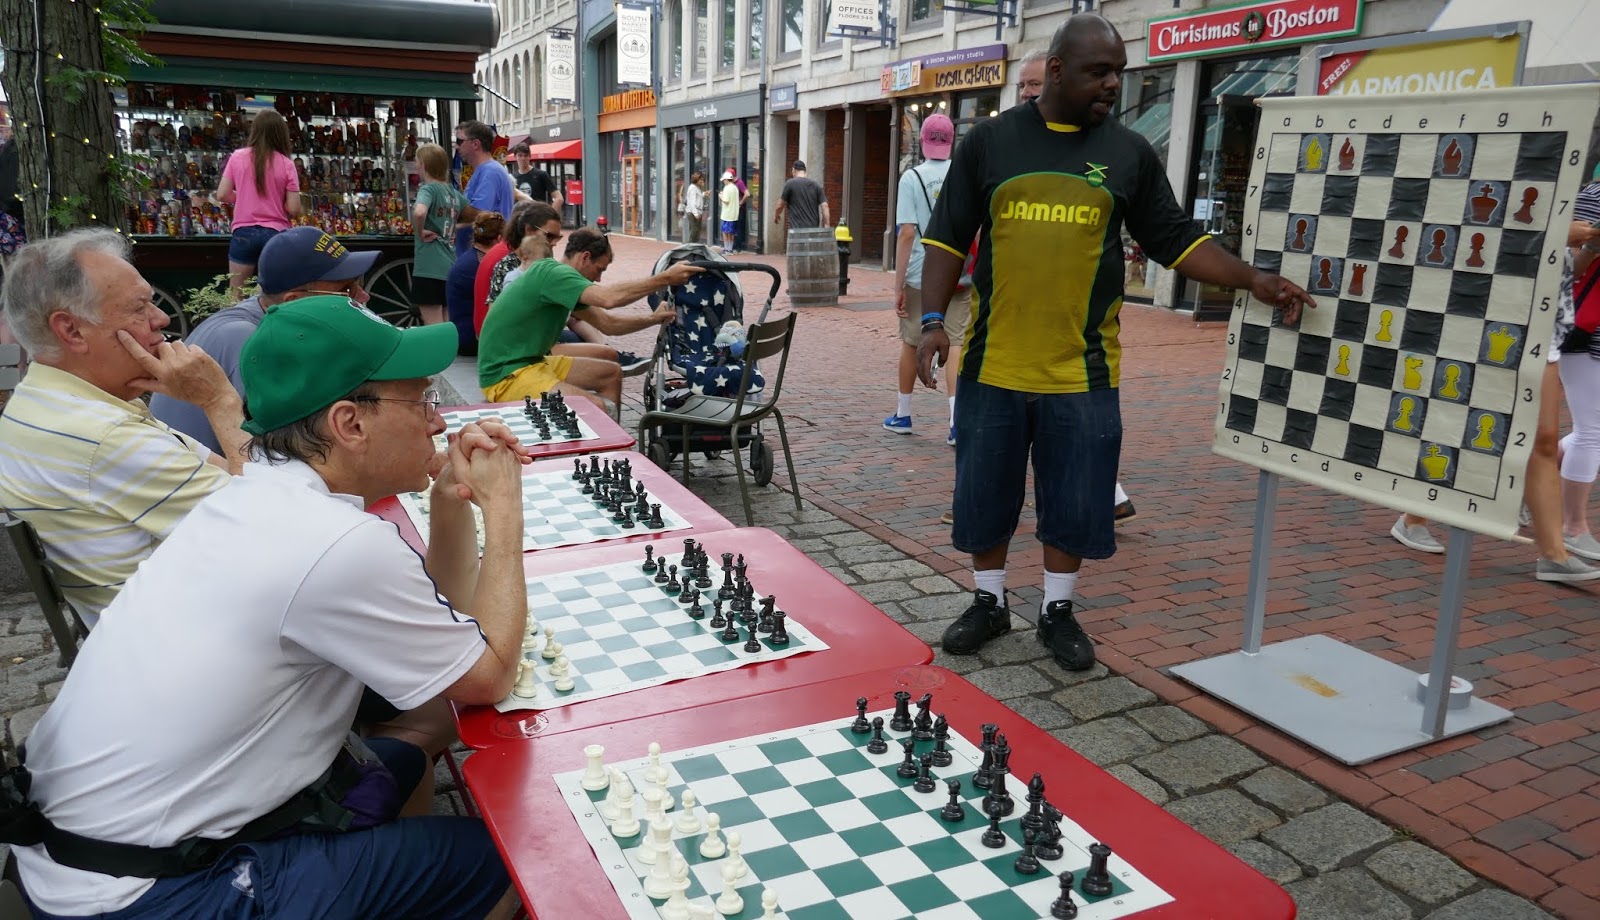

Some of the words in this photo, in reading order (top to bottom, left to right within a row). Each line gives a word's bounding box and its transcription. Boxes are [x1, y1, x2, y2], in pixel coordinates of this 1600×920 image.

[621, 14, 647, 22] SOUTH
[838, 5, 874, 15] OFFICES
[1157, 20, 1240, 52] Christmas
[1248, 20, 1259, 32] in
[1266, 6, 1340, 38] Boston
[935, 70, 963, 87] LOCAL
[1321, 58, 1351, 90] FREE!
[1283, 117, 1291, 127] a
[1315, 114, 1324, 129] b
[1348, 118, 1357, 129] c
[1382, 114, 1393, 129] d
[1418, 118, 1428, 129] e
[1459, 113, 1466, 128] f
[1497, 112, 1508, 128] g
[1541, 110, 1553, 127] h
[1256, 147, 1265, 160] 8
[1568, 149, 1580, 167] 8
[1249, 185, 1258, 198] 7
[1001, 201, 1101, 226] JAMAICA
[1558, 200, 1570, 215] 7
[1245, 224, 1253, 236] 6
[1547, 249, 1557, 265] 6
[1235, 297, 1243, 309] 4
[1539, 296, 1551, 312] 5
[1227, 333, 1236, 346] 3
[1528, 343, 1542, 360] 4
[1222, 368, 1232, 381] 2
[1523, 387, 1533, 403] 3
[1514, 431, 1527, 447] 2
[1232, 435, 1241, 445] a
[1261, 441, 1269, 454] b
[1290, 453, 1298, 463] c
[1320, 460, 1330, 473] d
[1353, 471, 1363, 482] e
[1391, 478, 1398, 491] f
[1427, 488, 1438, 502] g
[1466, 498, 1478, 513] h
[1508, 475, 1515, 490] 1
